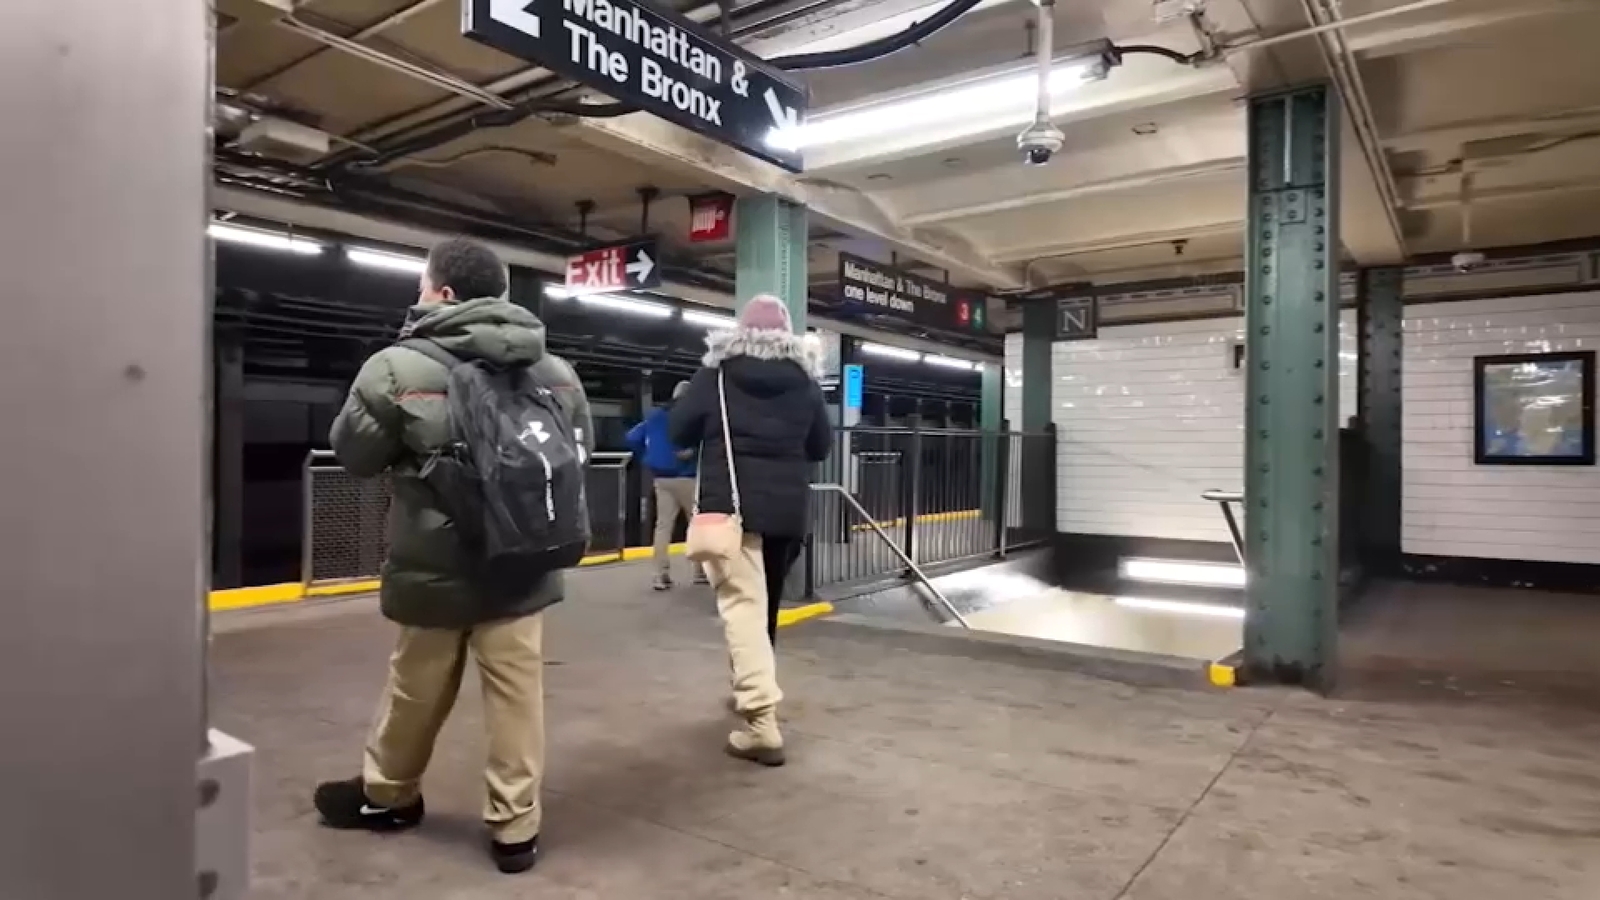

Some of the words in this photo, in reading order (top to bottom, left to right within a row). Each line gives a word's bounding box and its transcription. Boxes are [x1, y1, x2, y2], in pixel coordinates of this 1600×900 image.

[562, 19, 629, 83] The
[641, 56, 722, 127] Bronx
[730, 60, 750, 97] &
[565, 250, 621, 287] Exit
[844, 260, 895, 290] Manhattan
[844, 284, 865, 300] one
[866, 286, 889, 306] level
[890, 293, 914, 313] down
[961, 302, 969, 321] 3
[974, 307, 982, 324] 4
[1062, 309, 1085, 331] N
